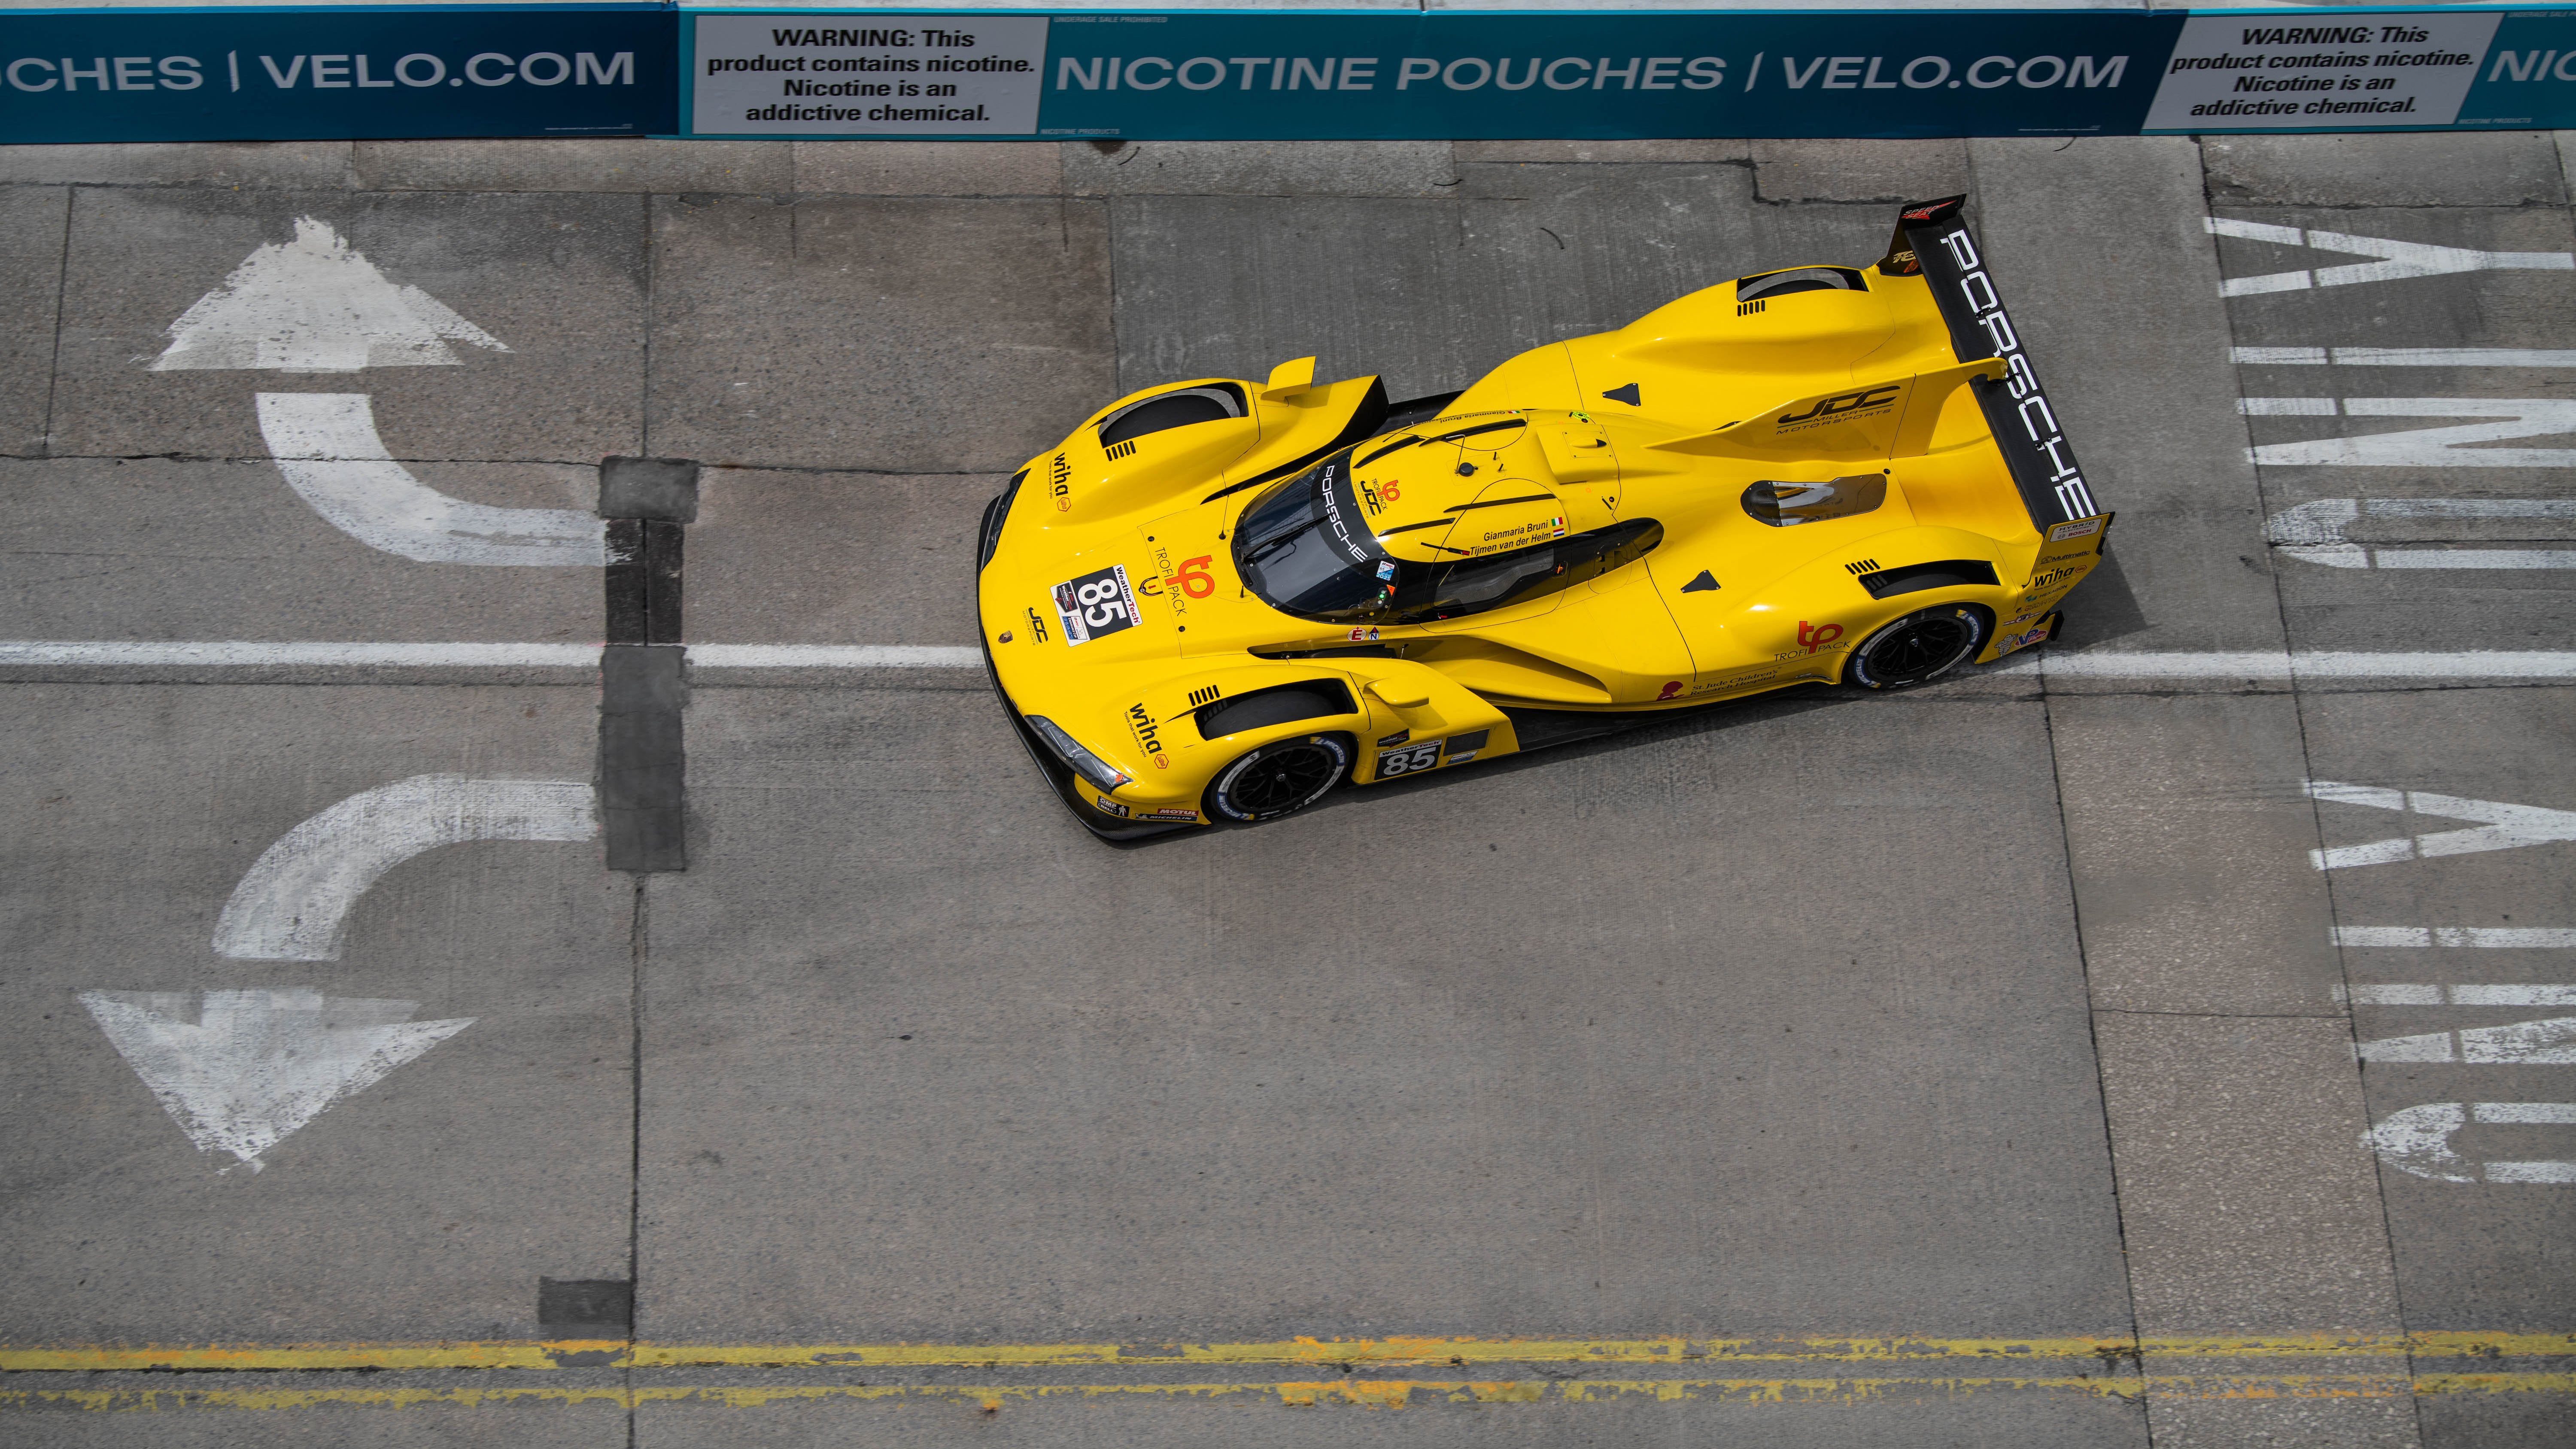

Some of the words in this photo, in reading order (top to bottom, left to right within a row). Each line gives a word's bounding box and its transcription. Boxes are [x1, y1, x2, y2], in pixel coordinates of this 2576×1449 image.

[772, 29, 914, 48] WARNING:
[922, 30, 975, 47] This
[2242, 27, 2373, 45] WARNING:
[2381, 27, 2429, 43] This
[259, 52, 635, 88] VELO.COM
[708, 55, 805, 76] product
[811, 55, 920, 72] contains
[926, 55, 1035, 73] nicotine.
[2170, 53, 2263, 74] product
[2267, 52, 2368, 69] contains
[2374, 50, 2475, 67] nicotine.
[1056, 57, 1378, 91] NICOTINE
[1397, 56, 1726, 91] POUCHES
[1783, 55, 2129, 88] VELO.COM
[784, 80, 890, 97] Nicotine
[898, 80, 919, 97] is
[925, 83, 956, 97] an
[2233, 76, 2334, 93] Nicotine
[2339, 75, 2360, 91] is
[2365, 78, 2396, 91] an
[746, 105, 861, 122] addictive
[868, 105, 990, 122] chemical.
[2190, 99, 2298, 116] addictive
[2304, 97, 2416, 115] chemical.
[1904, 205, 1939, 215] SPEED
[1906, 210, 1935, 219] SEAT
[1940, 229, 2096, 520] PORSCHE
[1777, 386, 1901, 424] JDC
[1776, 409, 1891, 435] MOTORSPORTS
[1813, 410, 1858, 422] MILLER
[1054, 452, 1071, 496] wiha
[1355, 484, 1369, 518] MOTORSPORTS
[1361, 481, 1381, 516] JDC
[1372, 478, 1381, 492] TROFI
[1378, 496, 1388, 510] PACK
[1322, 465, 1368, 562] PORSCHE
[1484, 526, 1524, 541] Gianmaria
[1527, 520, 1548, 532] Bruni
[1470, 544, 1496, 556] Tijmen
[1516, 537, 1529, 546] der
[1531, 532, 1550, 543] Helm
[2052, 551, 2090, 561] Multimatic
[1155, 547, 1173, 577] TROFI
[1168, 586, 1187, 616] PACK
[2035, 567, 2075, 587] wiha
[1116, 567, 1139, 623] WeatherTech
[2039, 584, 2068, 598] HEXAGON
[1078, 579, 1127, 627] 85
[1022, 611, 1035, 645] MOTORSPORTS
[1028, 607, 1048, 643] JDC
[1352, 630, 1362, 640] E
[2018, 629, 2038, 645] VP
[1774, 649, 1807, 662] TROFI
[1818, 641, 1851, 652] PACK
[1690, 685, 1730, 696] Research
[1731, 675, 1776, 689] Hospital
[1706, 680, 1728, 689] Jude
[1729, 670, 1778, 684] Children's
[1130, 702, 1162, 754] wiha
[1382, 741, 1439, 756] WeatherTech
[1384, 747, 1436, 775] 85
[1100, 798, 1117, 808] OMP
